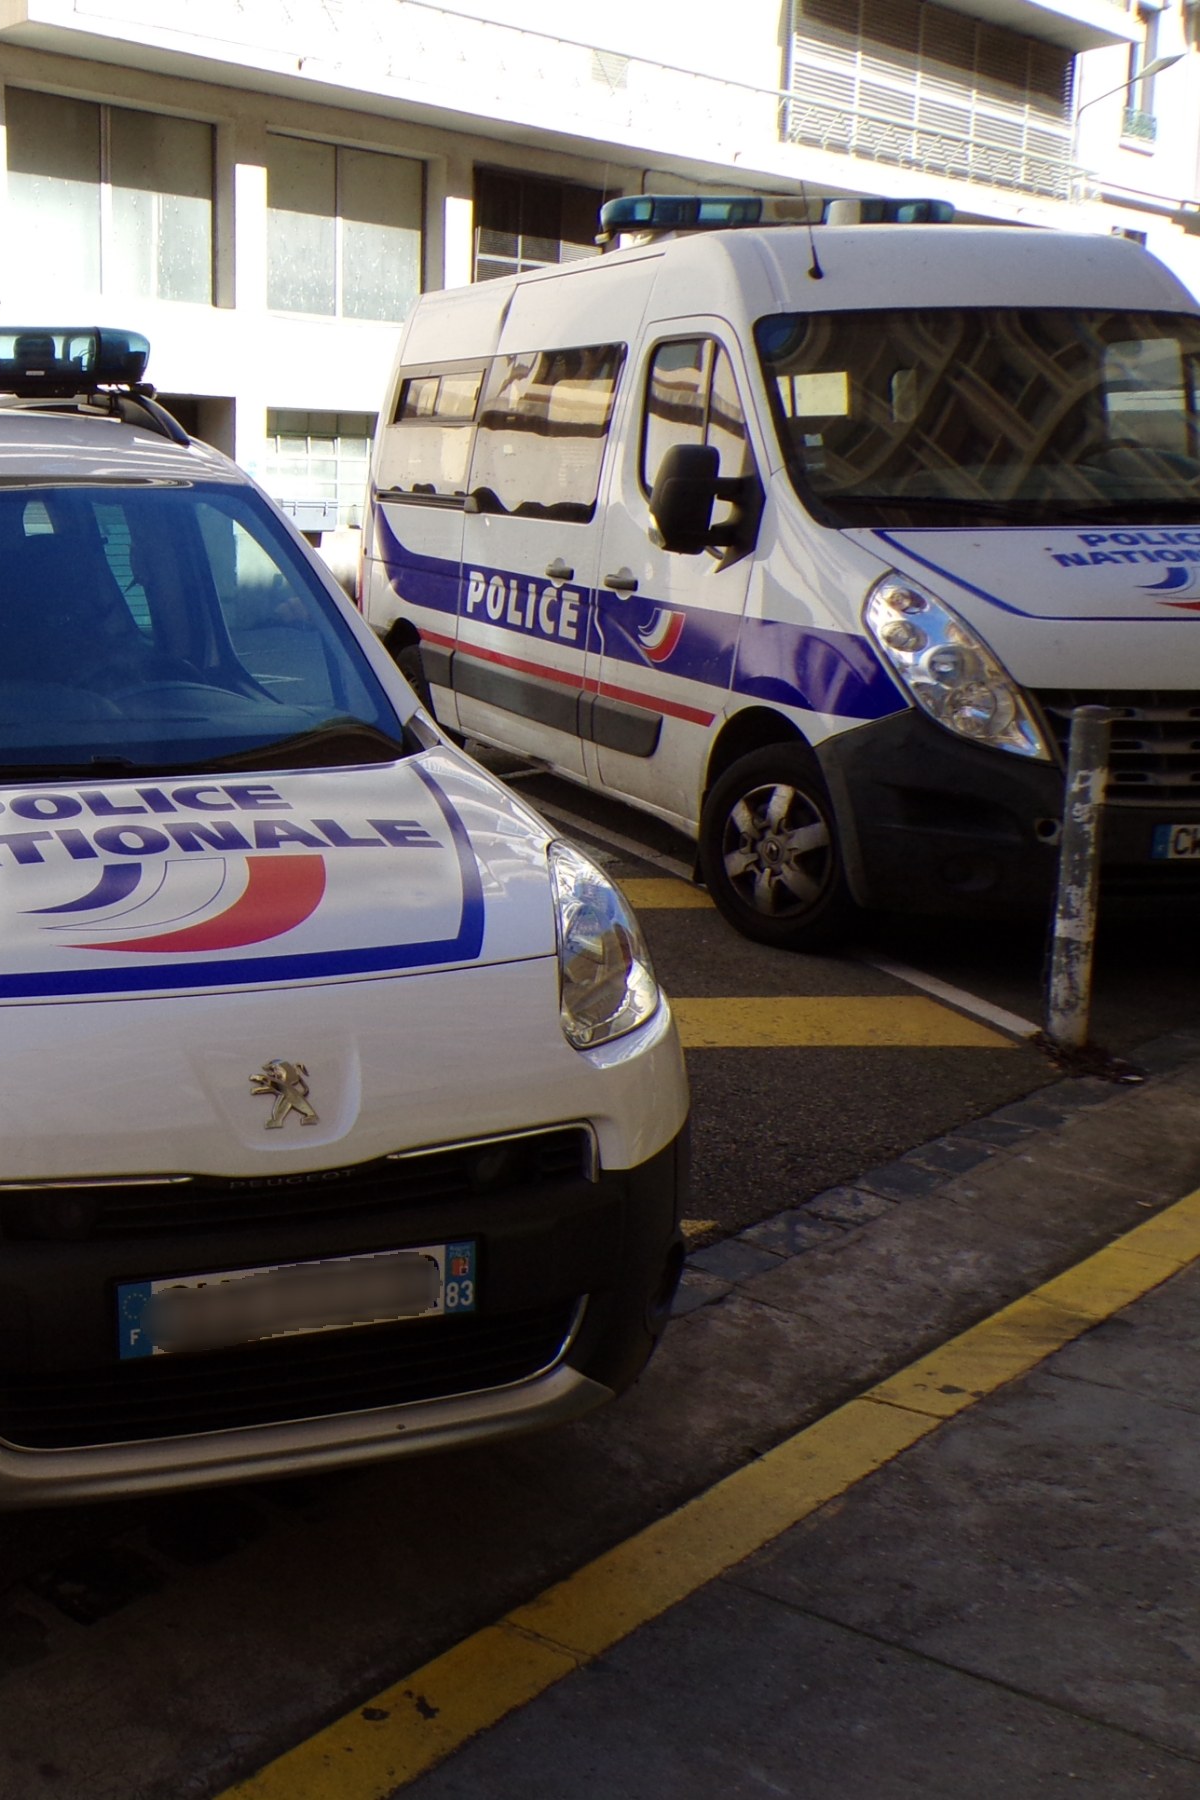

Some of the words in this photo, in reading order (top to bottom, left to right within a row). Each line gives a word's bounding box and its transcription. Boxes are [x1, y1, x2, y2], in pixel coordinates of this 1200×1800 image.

[466, 570, 581, 640] POLICE
[229, 1168, 357, 1189] PEUGEOT
[446, 1280, 474, 1308] 83
[130, 1328, 142, 1347] F
